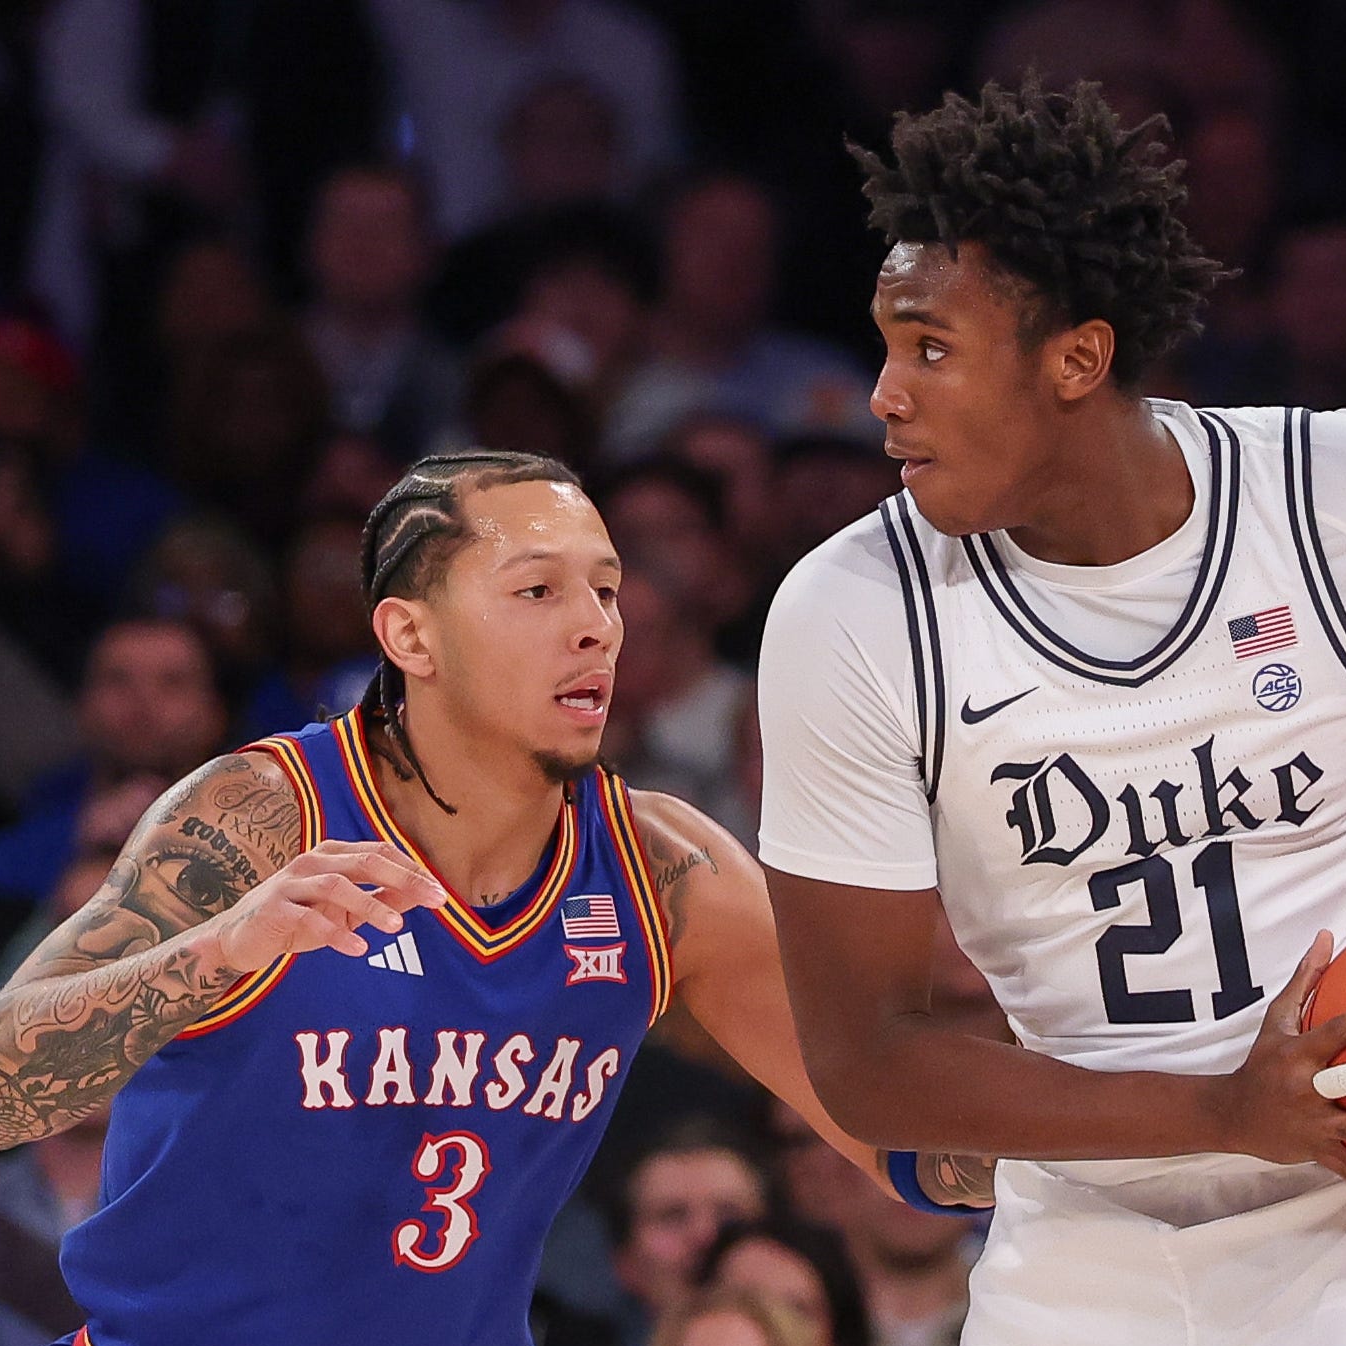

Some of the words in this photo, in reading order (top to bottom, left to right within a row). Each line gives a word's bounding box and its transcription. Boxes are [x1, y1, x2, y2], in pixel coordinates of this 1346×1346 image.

[1258, 675, 1297, 696] ACC
[991, 734, 1325, 866] Duke
[565, 944, 626, 985] XII
[1088, 841, 1265, 1025] 21
[295, 1026, 620, 1123] KANSAS
[392, 1129, 492, 1272] 3
